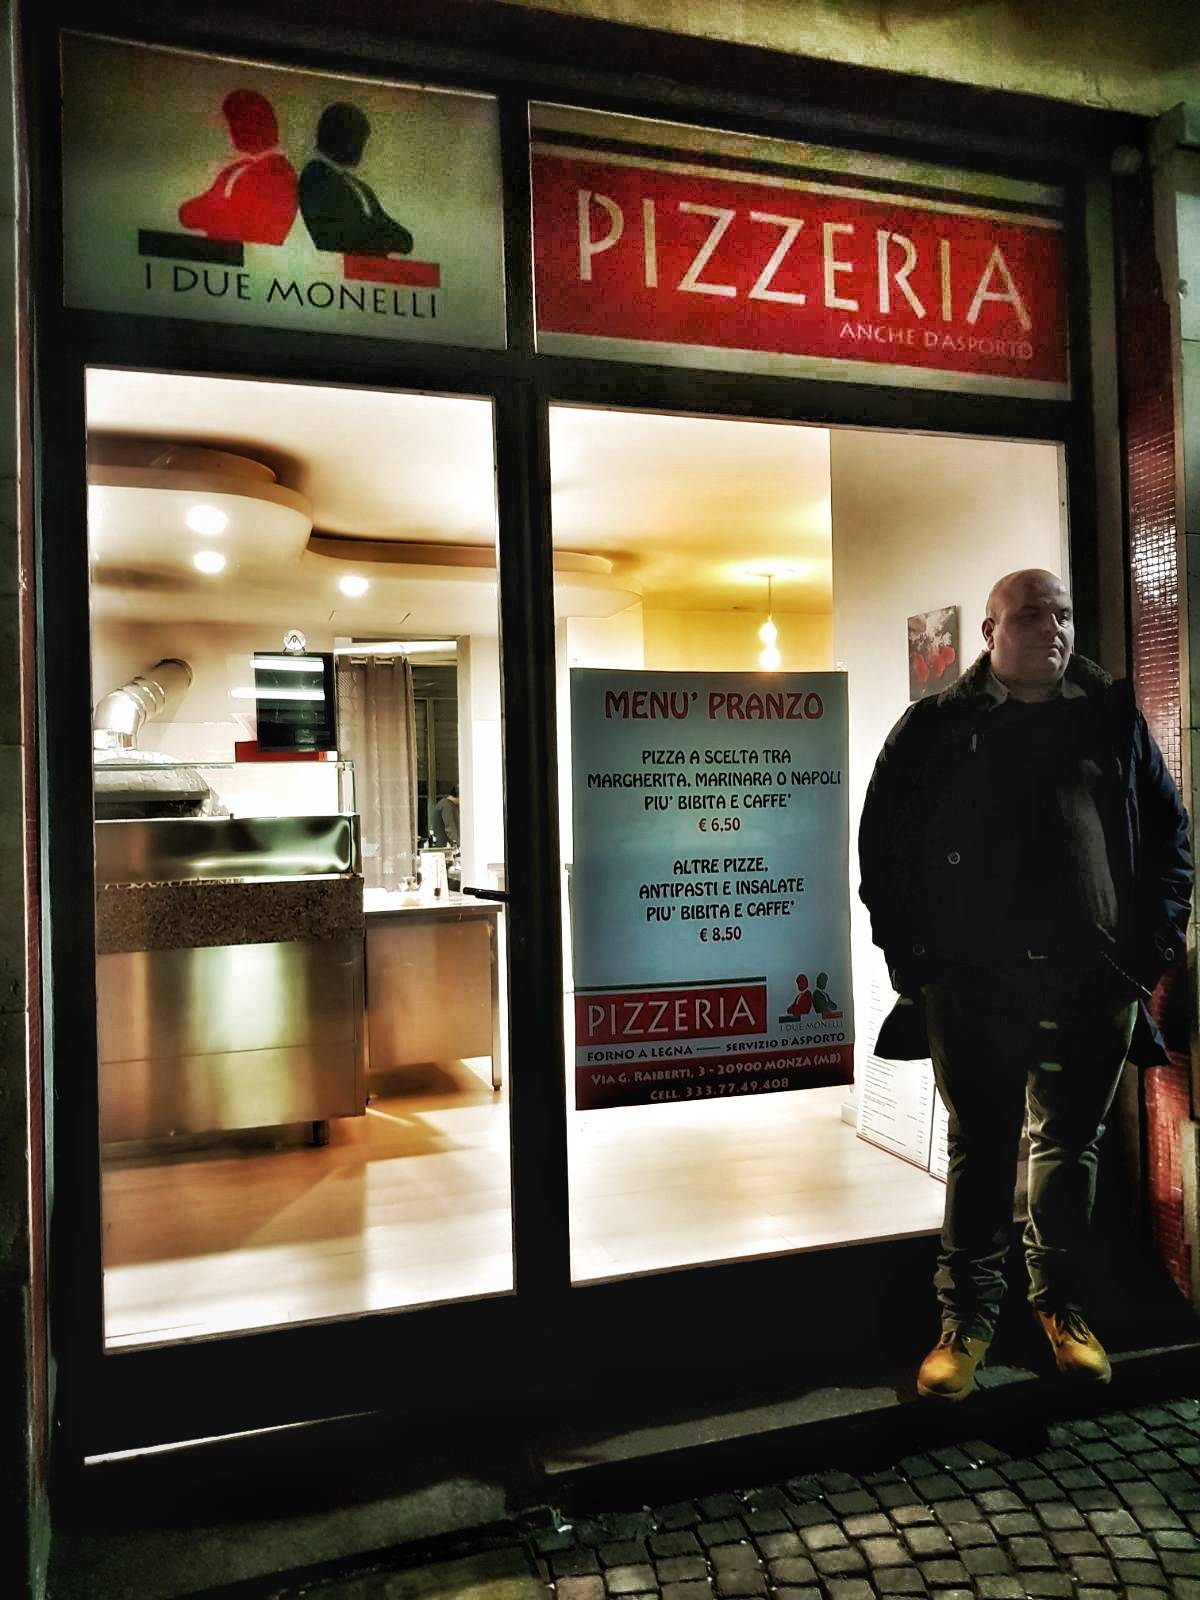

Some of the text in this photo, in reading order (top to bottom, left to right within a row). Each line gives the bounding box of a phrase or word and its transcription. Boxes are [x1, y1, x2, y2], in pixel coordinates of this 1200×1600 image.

[578, 189, 1032, 331] PIZZERIA
[145, 263, 437, 319] I DUE MONELLI
[840, 322, 914, 345] ANCHE
[605, 690, 824, 720] MENU' PRANZO
[642, 749, 792, 765] PIZZA A SCELTA TRA
[695, 772, 772, 787] MARINARA
[777, 772, 786, 786] O
[791, 771, 841, 786] NAPOLI
[644, 793, 792, 810] PIU' BIBITA E CAFFE'
[698, 818, 707, 832] €
[673, 858, 719, 875] ALTRE
[639, 877, 804, 899] ANTIPASTI E INSALATE
[646, 901, 795, 922] PIU' BIBITA E CAFFE'
[699, 928, 708, 943] €
[588, 996, 756, 1038] PIZZERIA
[587, 1032, 845, 1063] FORNO A LEGNA SERVIZIO D'ASPORTO
[591, 1073, 616, 1086] VIA
[618, 1071, 631, 1083] G.
[634, 1068, 694, 1083] RAIBERTI,
[698, 1066, 706, 1077] 3
[717, 1061, 762, 1076] 20900
[765, 1056, 811, 1071] MONZA
[650, 1077, 789, 1101] CELL. 333.77.49.408
